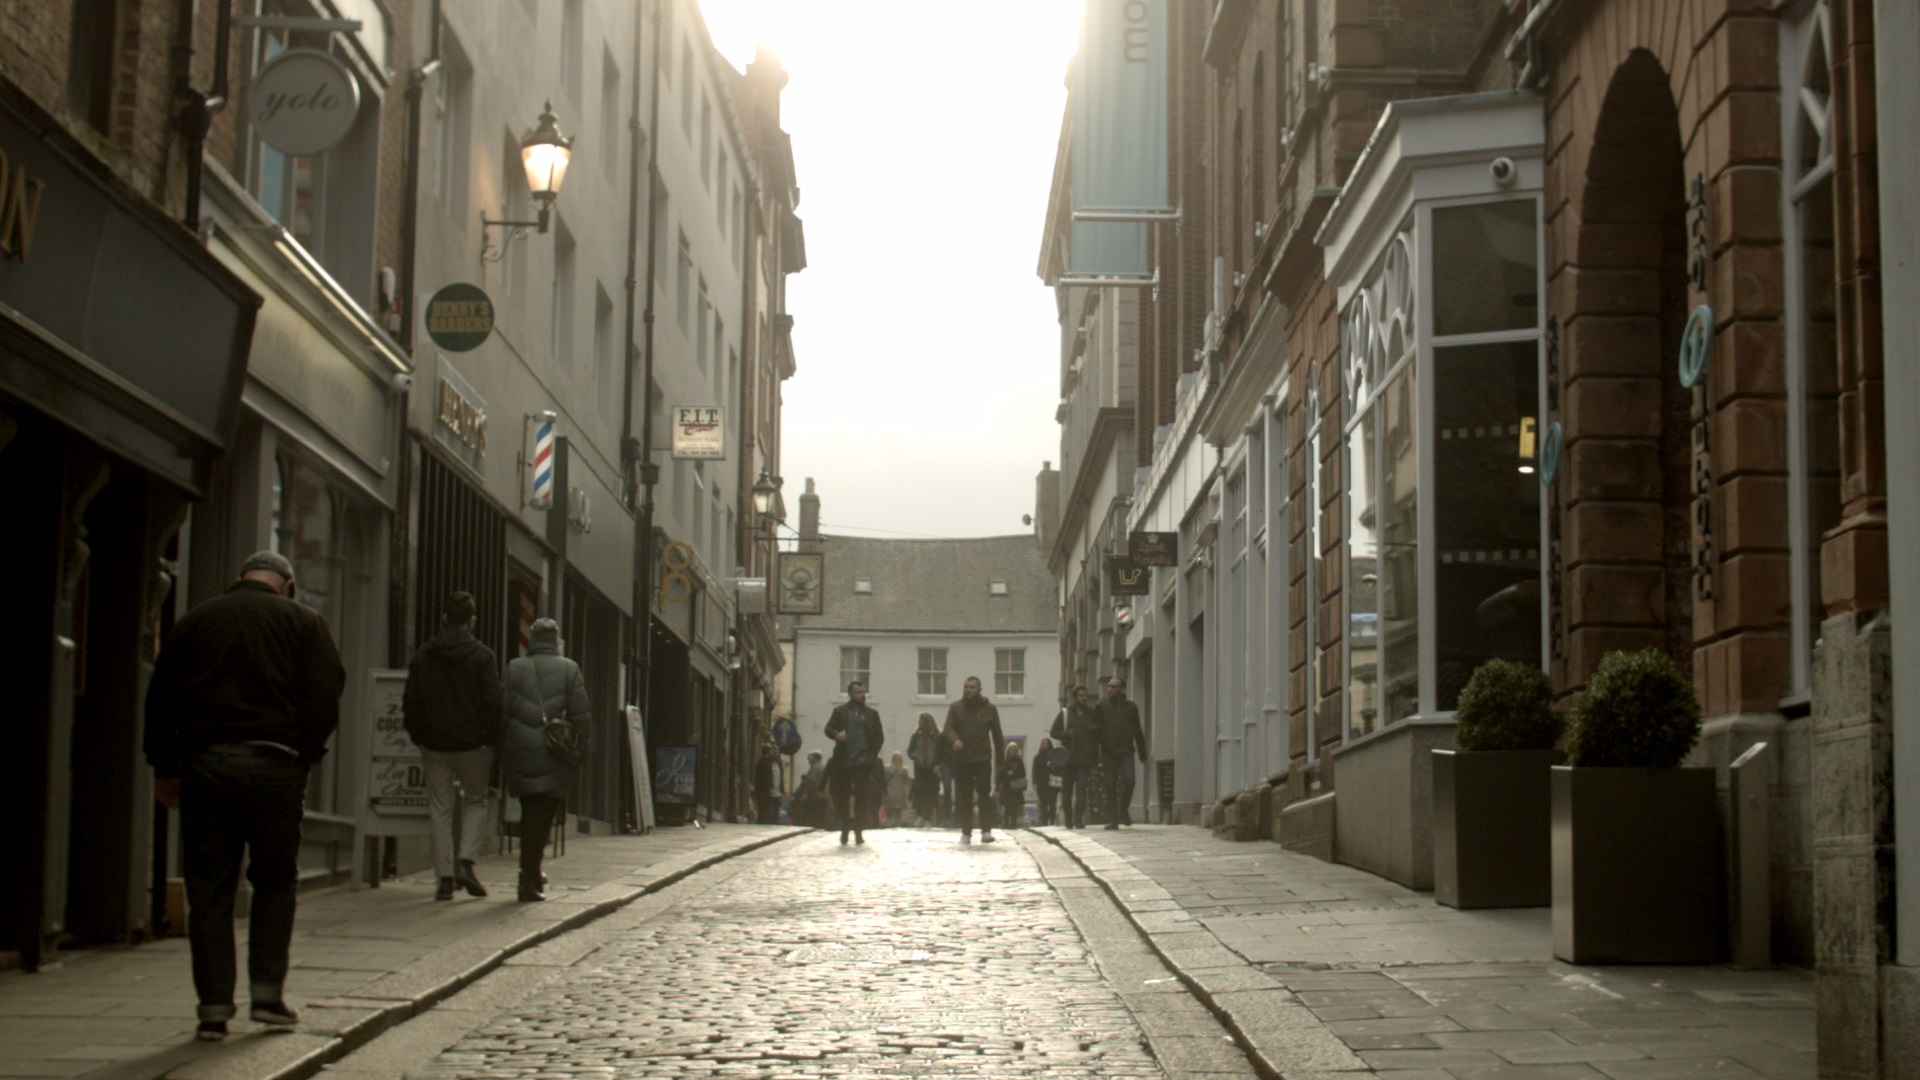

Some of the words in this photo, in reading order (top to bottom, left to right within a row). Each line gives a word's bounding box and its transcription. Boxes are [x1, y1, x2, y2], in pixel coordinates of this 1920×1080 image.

[257, 82, 341, 123] yolo
[431, 300, 490, 316] HENRY'S
[429, 317, 492, 333] BARBERS
